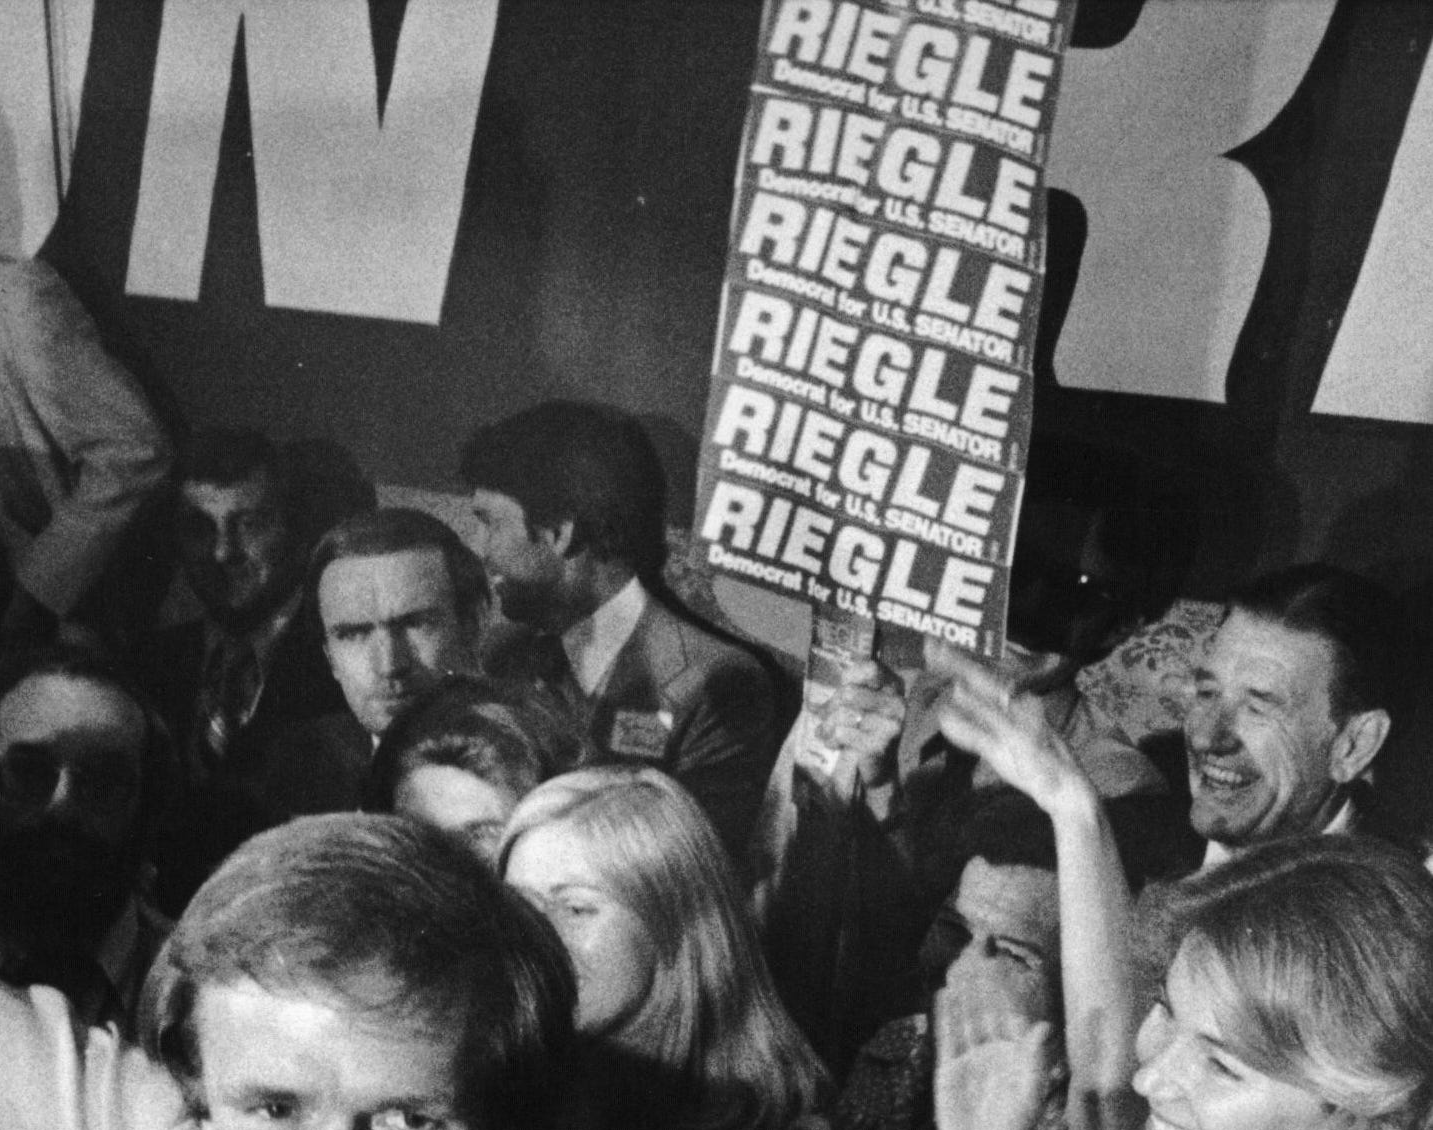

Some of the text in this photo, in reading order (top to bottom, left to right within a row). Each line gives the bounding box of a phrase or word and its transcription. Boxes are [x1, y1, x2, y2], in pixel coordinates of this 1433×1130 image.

[769, 0, 1055, 128] RIEGLE
[964, 0, 1052, 46] SENATOR
[750, 99, 1038, 235] RIEGLE
[868, 86, 898, 113] for
[902, 95, 944, 126] U.S.
[945, 105, 1034, 154] SENATOR
[738, 191, 1033, 339] RIEGLE
[759, 167, 862, 204] Democrat
[884, 197, 925, 229] U.S.
[928, 210, 1025, 260] SENATOR
[729, 290, 1021, 438] RIEGLE
[746, 257, 836, 306] Democrat
[837, 291, 867, 318] for
[871, 301, 911, 332] U.S.
[914, 313, 1013, 364] SENATOR
[712, 384, 1006, 536] RIEGLE
[736, 355, 1002, 462] Democrat for U.S. SENATOR
[701, 480, 995, 627] RIEGLE
[719, 448, 983, 558] Democrat for U.S. SENATOR
[708, 543, 803, 592] Democrat
[807, 575, 831, 602] for
[835, 588, 873, 620] U.S.
[876, 600, 978, 649] SENATOR
